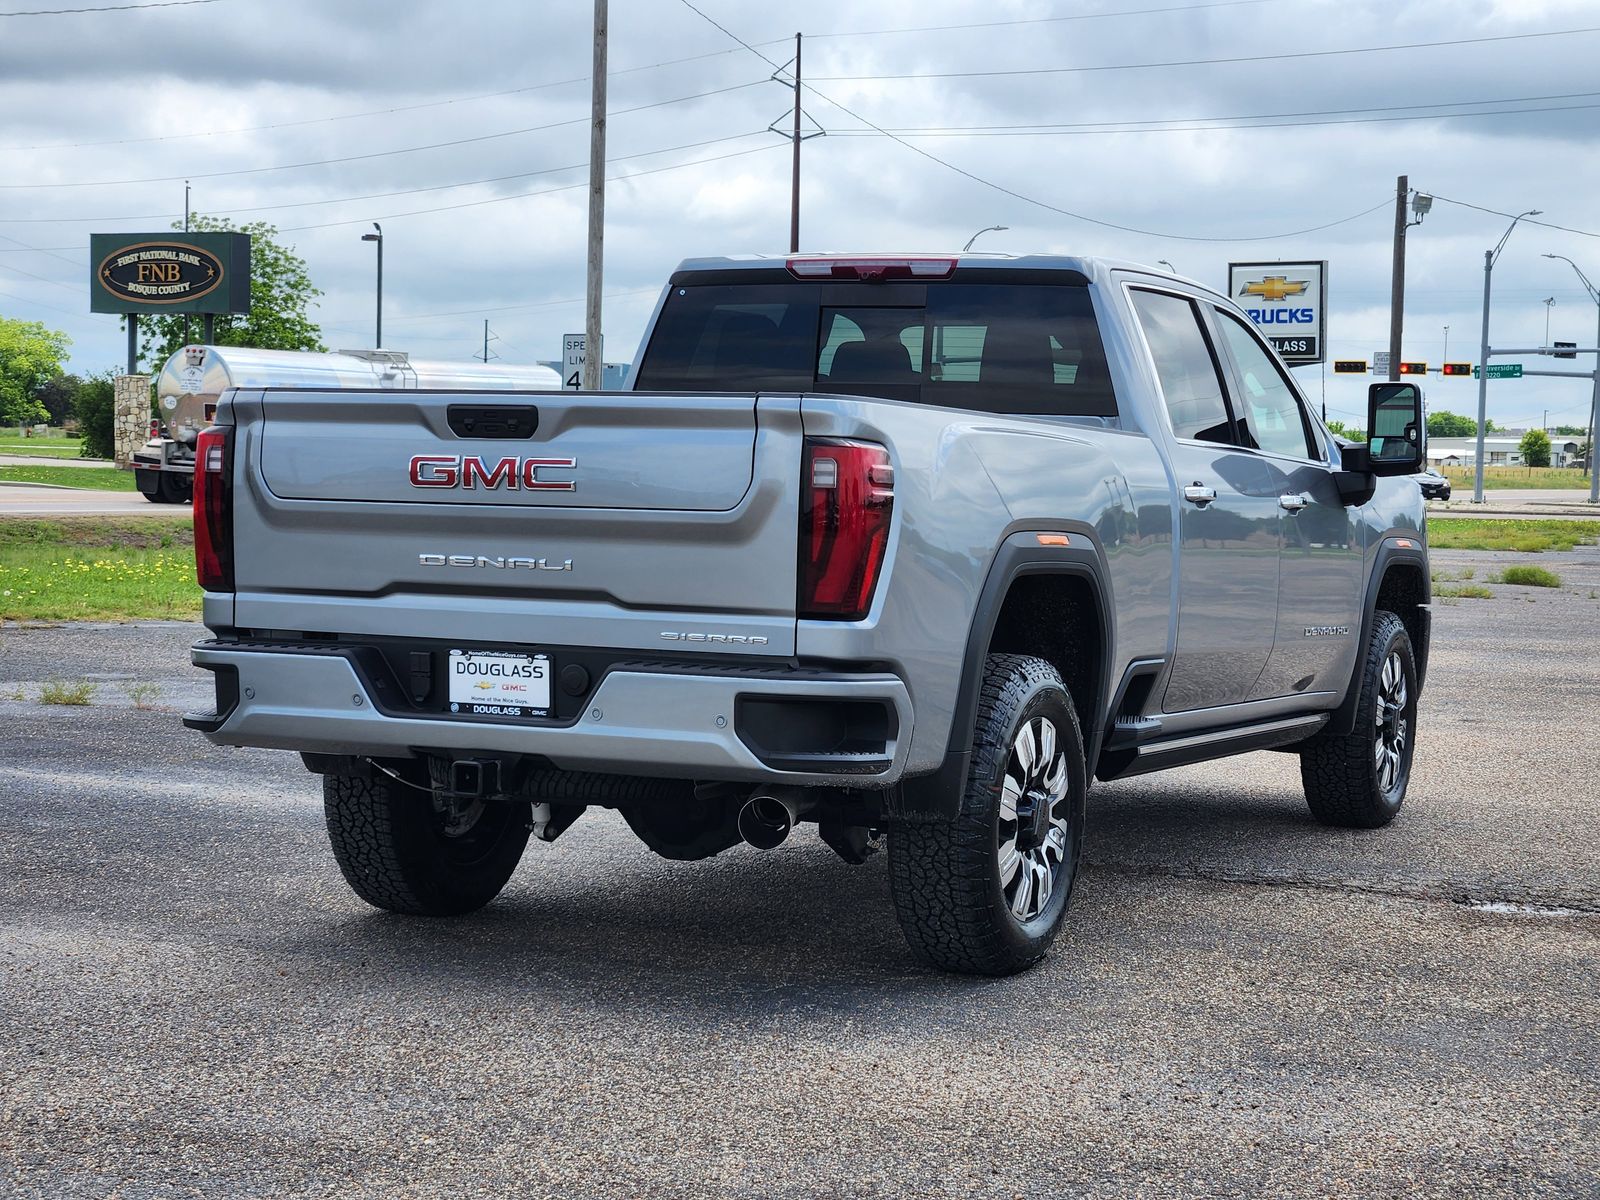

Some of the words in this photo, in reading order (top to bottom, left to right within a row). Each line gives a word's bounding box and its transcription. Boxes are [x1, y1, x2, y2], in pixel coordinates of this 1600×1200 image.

[117, 251, 138, 266] FIRST
[140, 250, 178, 260] NATIONAL
[178, 252, 200, 266] BANK
[137, 263, 181, 282] FNB
[127, 282, 158, 295] BOSQUE
[158, 282, 190, 295] COUNTY
[1245, 308, 1313, 324] RUCKS
[566, 341, 586, 350] SPE
[1270, 341, 1307, 352] LASS
[569, 356, 586, 365] LIM
[566, 371, 582, 390] 4
[408, 454, 577, 492] GMC
[418, 553, 574, 572] DENALI
[660, 631, 769, 645] SIERRA
[456, 662, 544, 678] DOUGLASS
[473, 705, 521, 716] DOUGLASS
